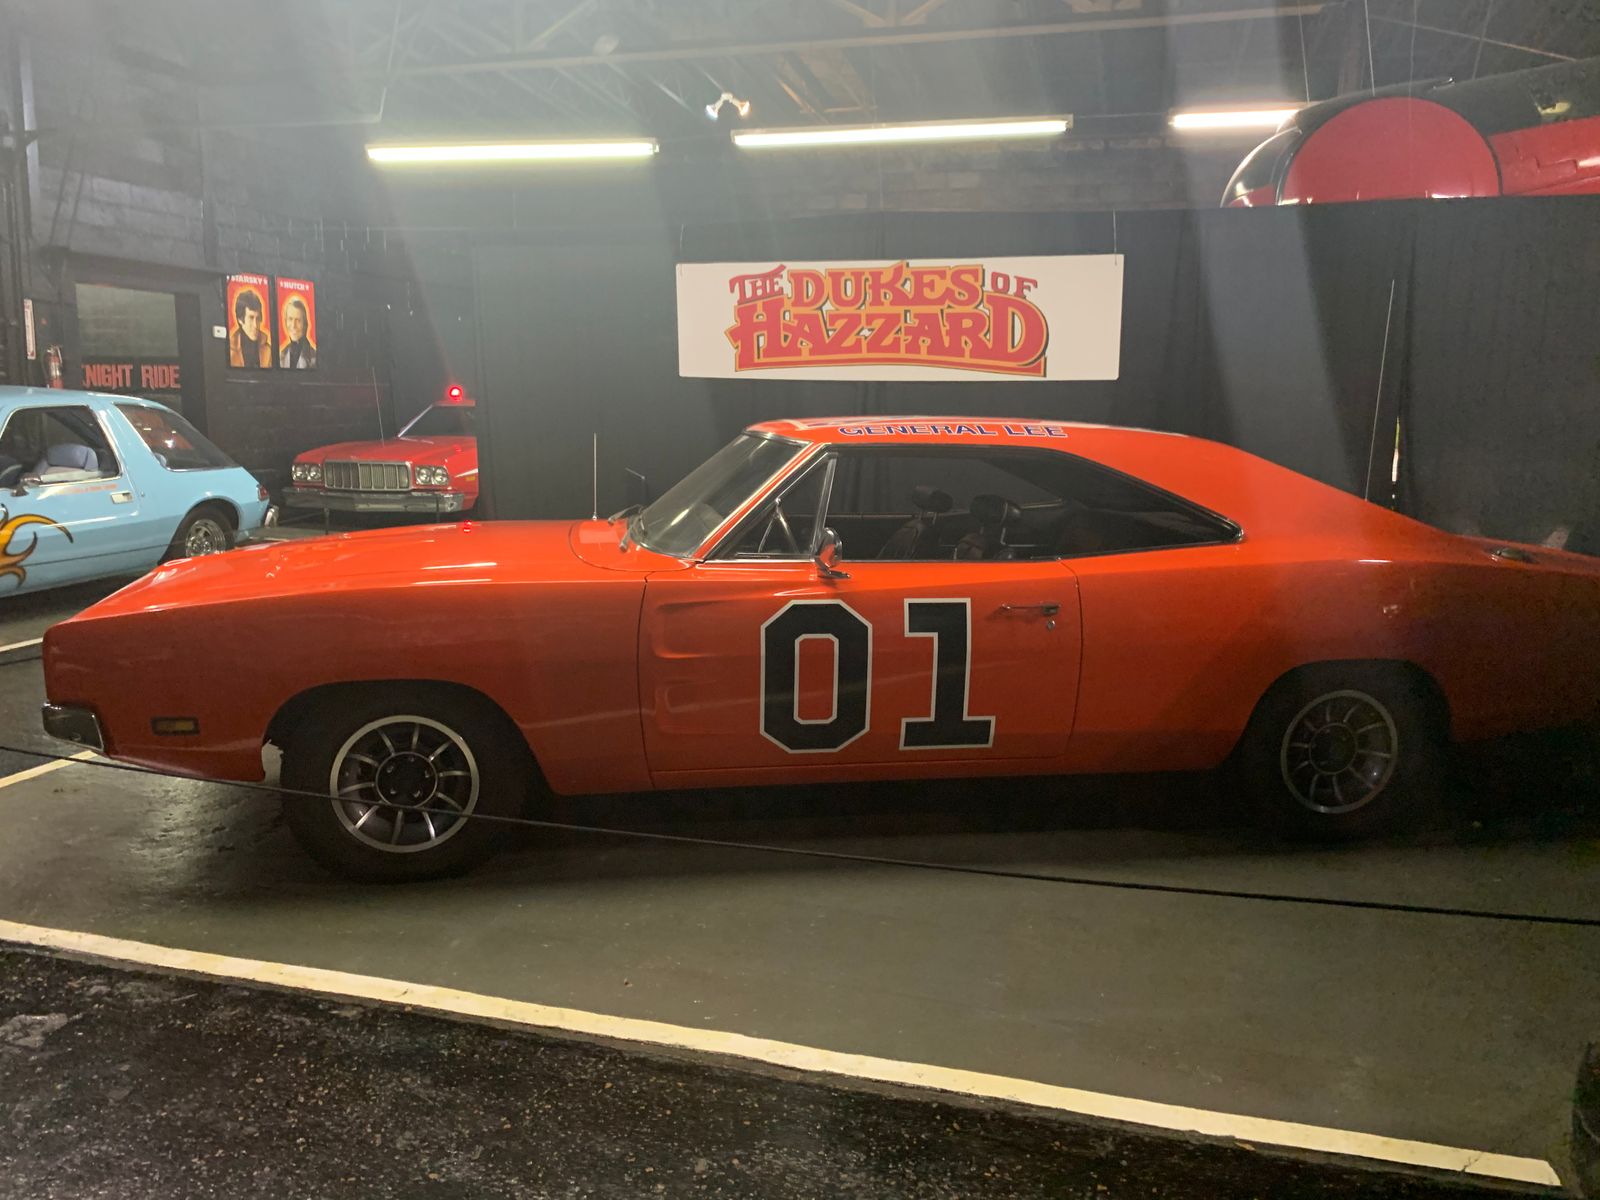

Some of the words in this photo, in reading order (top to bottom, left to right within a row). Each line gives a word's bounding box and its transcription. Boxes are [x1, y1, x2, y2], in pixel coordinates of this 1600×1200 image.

[729, 264, 786, 300] THE
[788, 262, 984, 311] DUKES
[991, 271, 1038, 298] OF
[725, 293, 1048, 374] HAZZARD
[82, 364, 133, 389] NIGHT
[141, 364, 181, 389] RIDE
[838, 423, 998, 437] GENERAL
[1001, 425, 1068, 438] LEE
[760, 597, 996, 754] 01
